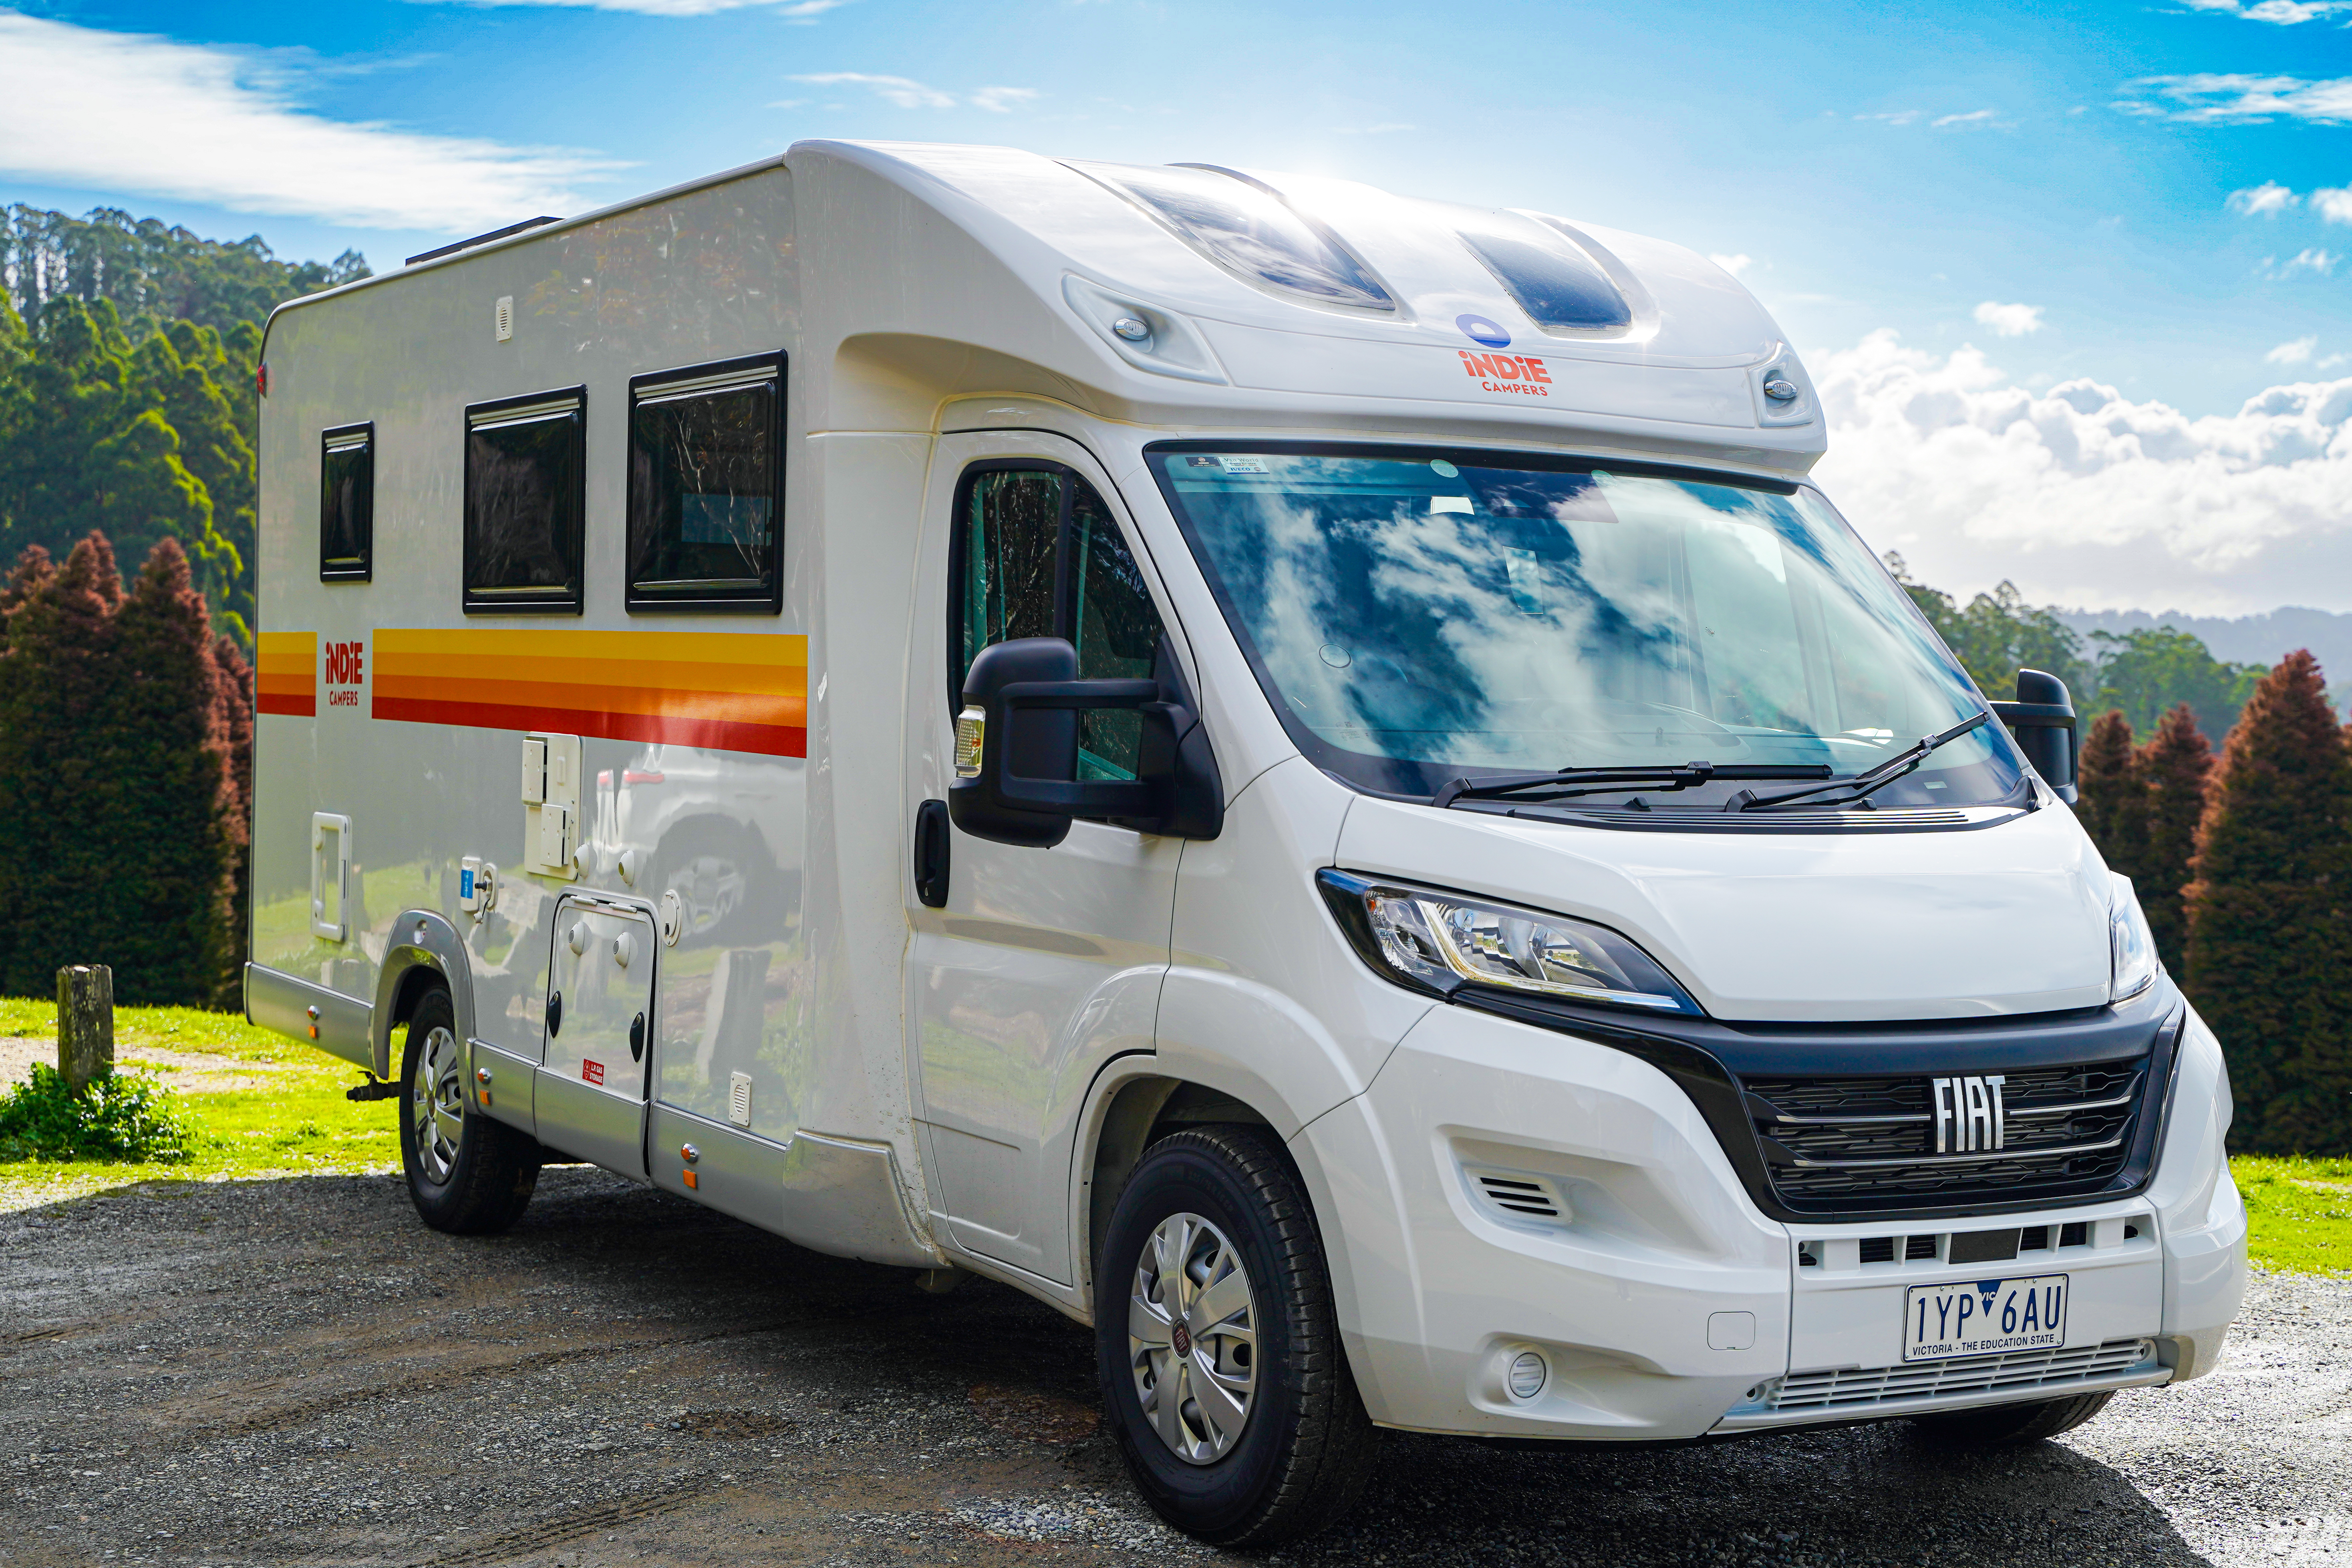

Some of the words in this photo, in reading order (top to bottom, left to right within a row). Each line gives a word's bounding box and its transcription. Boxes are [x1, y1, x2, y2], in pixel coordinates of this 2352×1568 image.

[1482, 381, 1548, 396] CAMPERS
[329, 690, 358, 706] CAMPERS
[590, 1072, 603, 1083] STORAGE
[1933, 1075, 2006, 1153] FIAT
[1979, 1291, 1996, 1302] VIC
[1918, 1293, 1974, 1343] 1YP
[2002, 1285, 2062, 1334] 6AU
[1175, 1328, 1187, 1351] FIAT
[1913, 1344, 1953, 1356] VICTORIA
[1962, 1341, 1978, 1351] THE
[1981, 1337, 2028, 1350] EDUCATION
[2030, 1334, 2054, 1345] STATE
